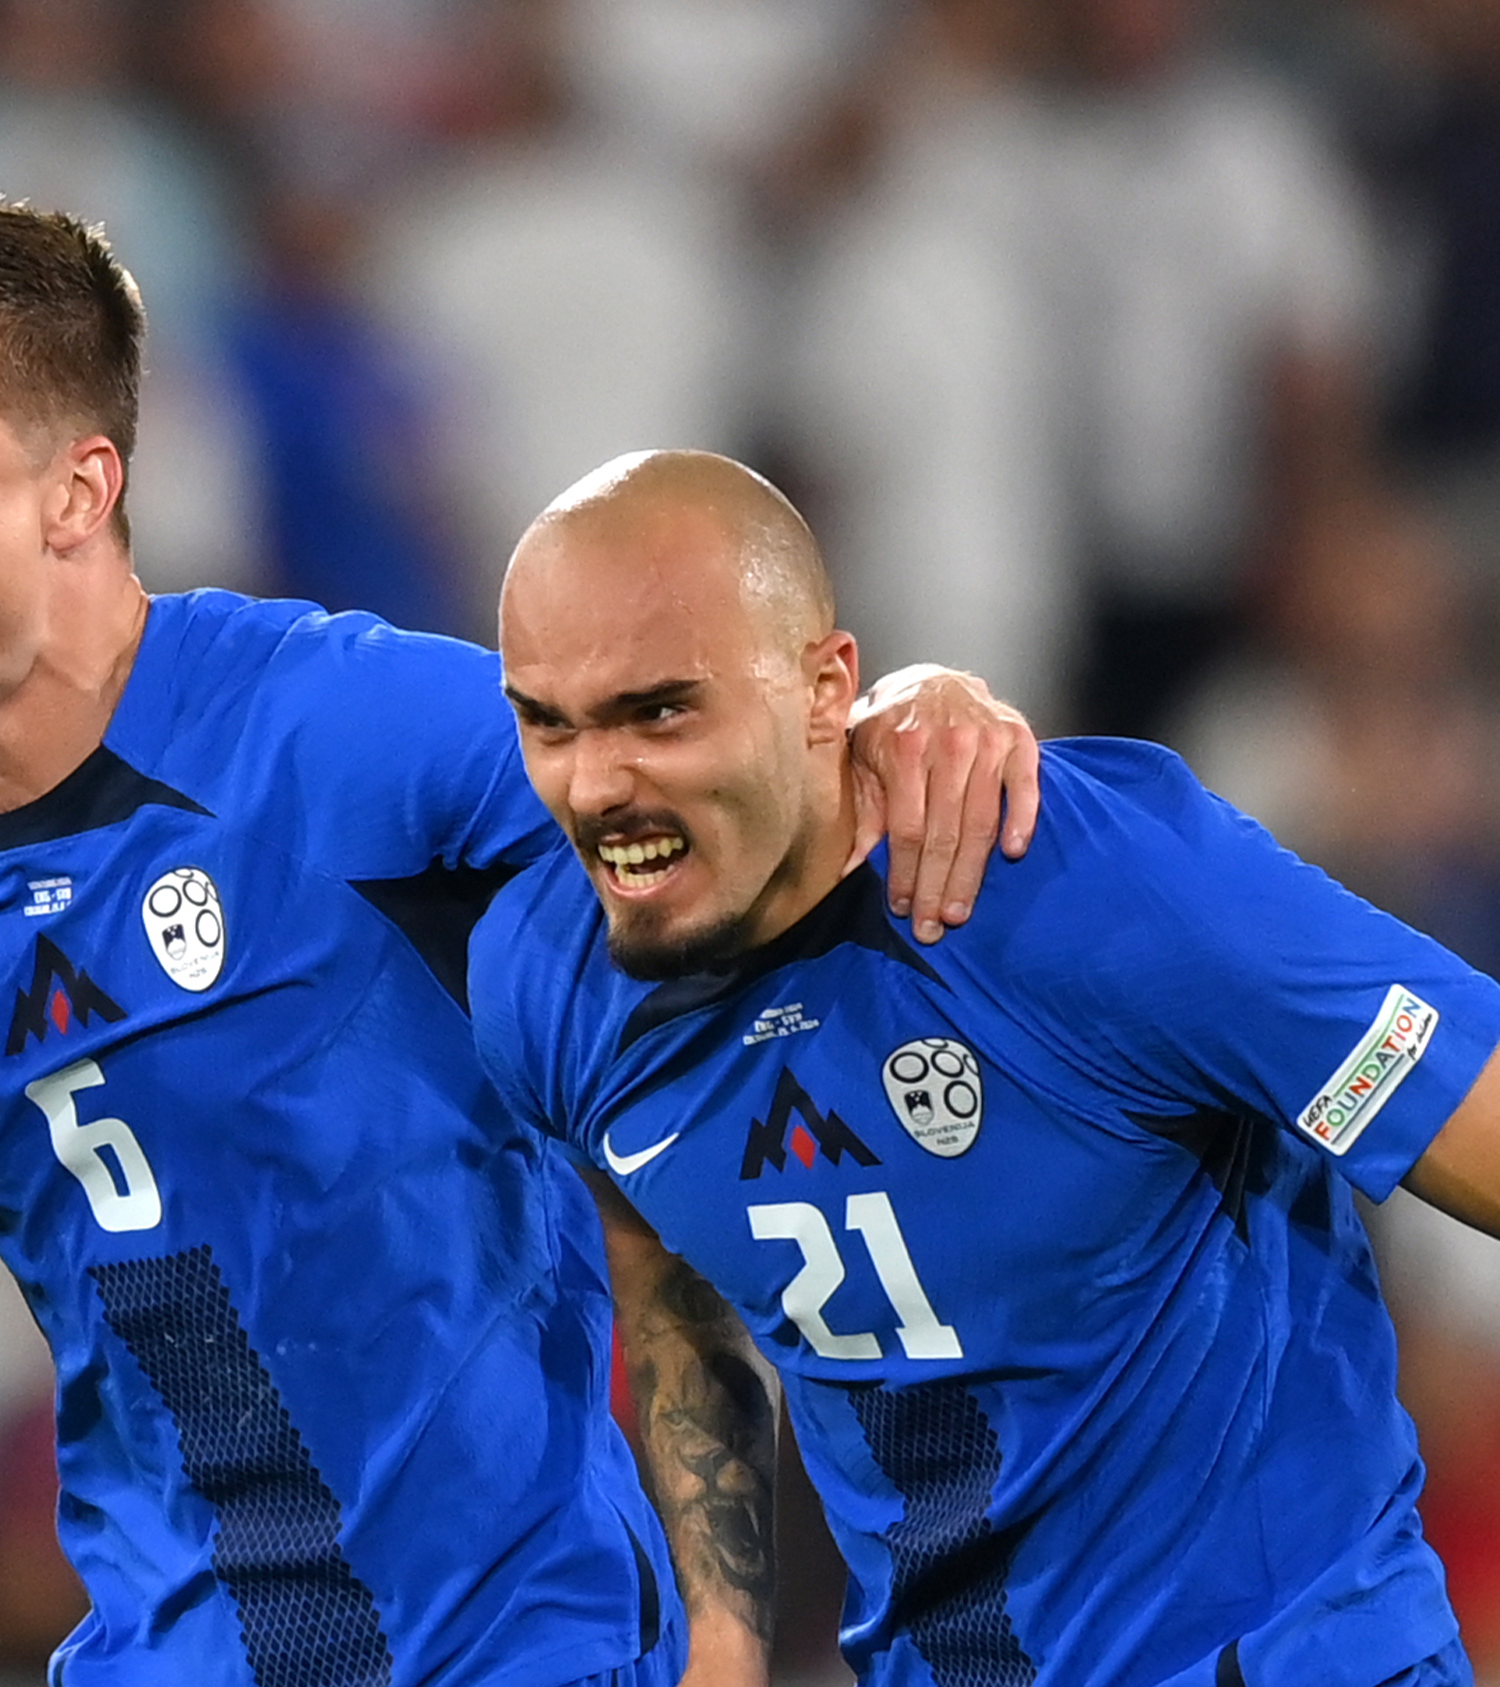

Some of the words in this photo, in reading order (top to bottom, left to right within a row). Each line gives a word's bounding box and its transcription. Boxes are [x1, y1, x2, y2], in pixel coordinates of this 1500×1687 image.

[1303, 1094, 1332, 1128] UEFA
[1313, 998, 1422, 1141] FOUNDATION
[25, 1057, 163, 1232] 6
[914, 1121, 975, 1138] SLOVENIJA
[936, 1136, 959, 1146] NZS
[747, 1191, 964, 1360] 21
